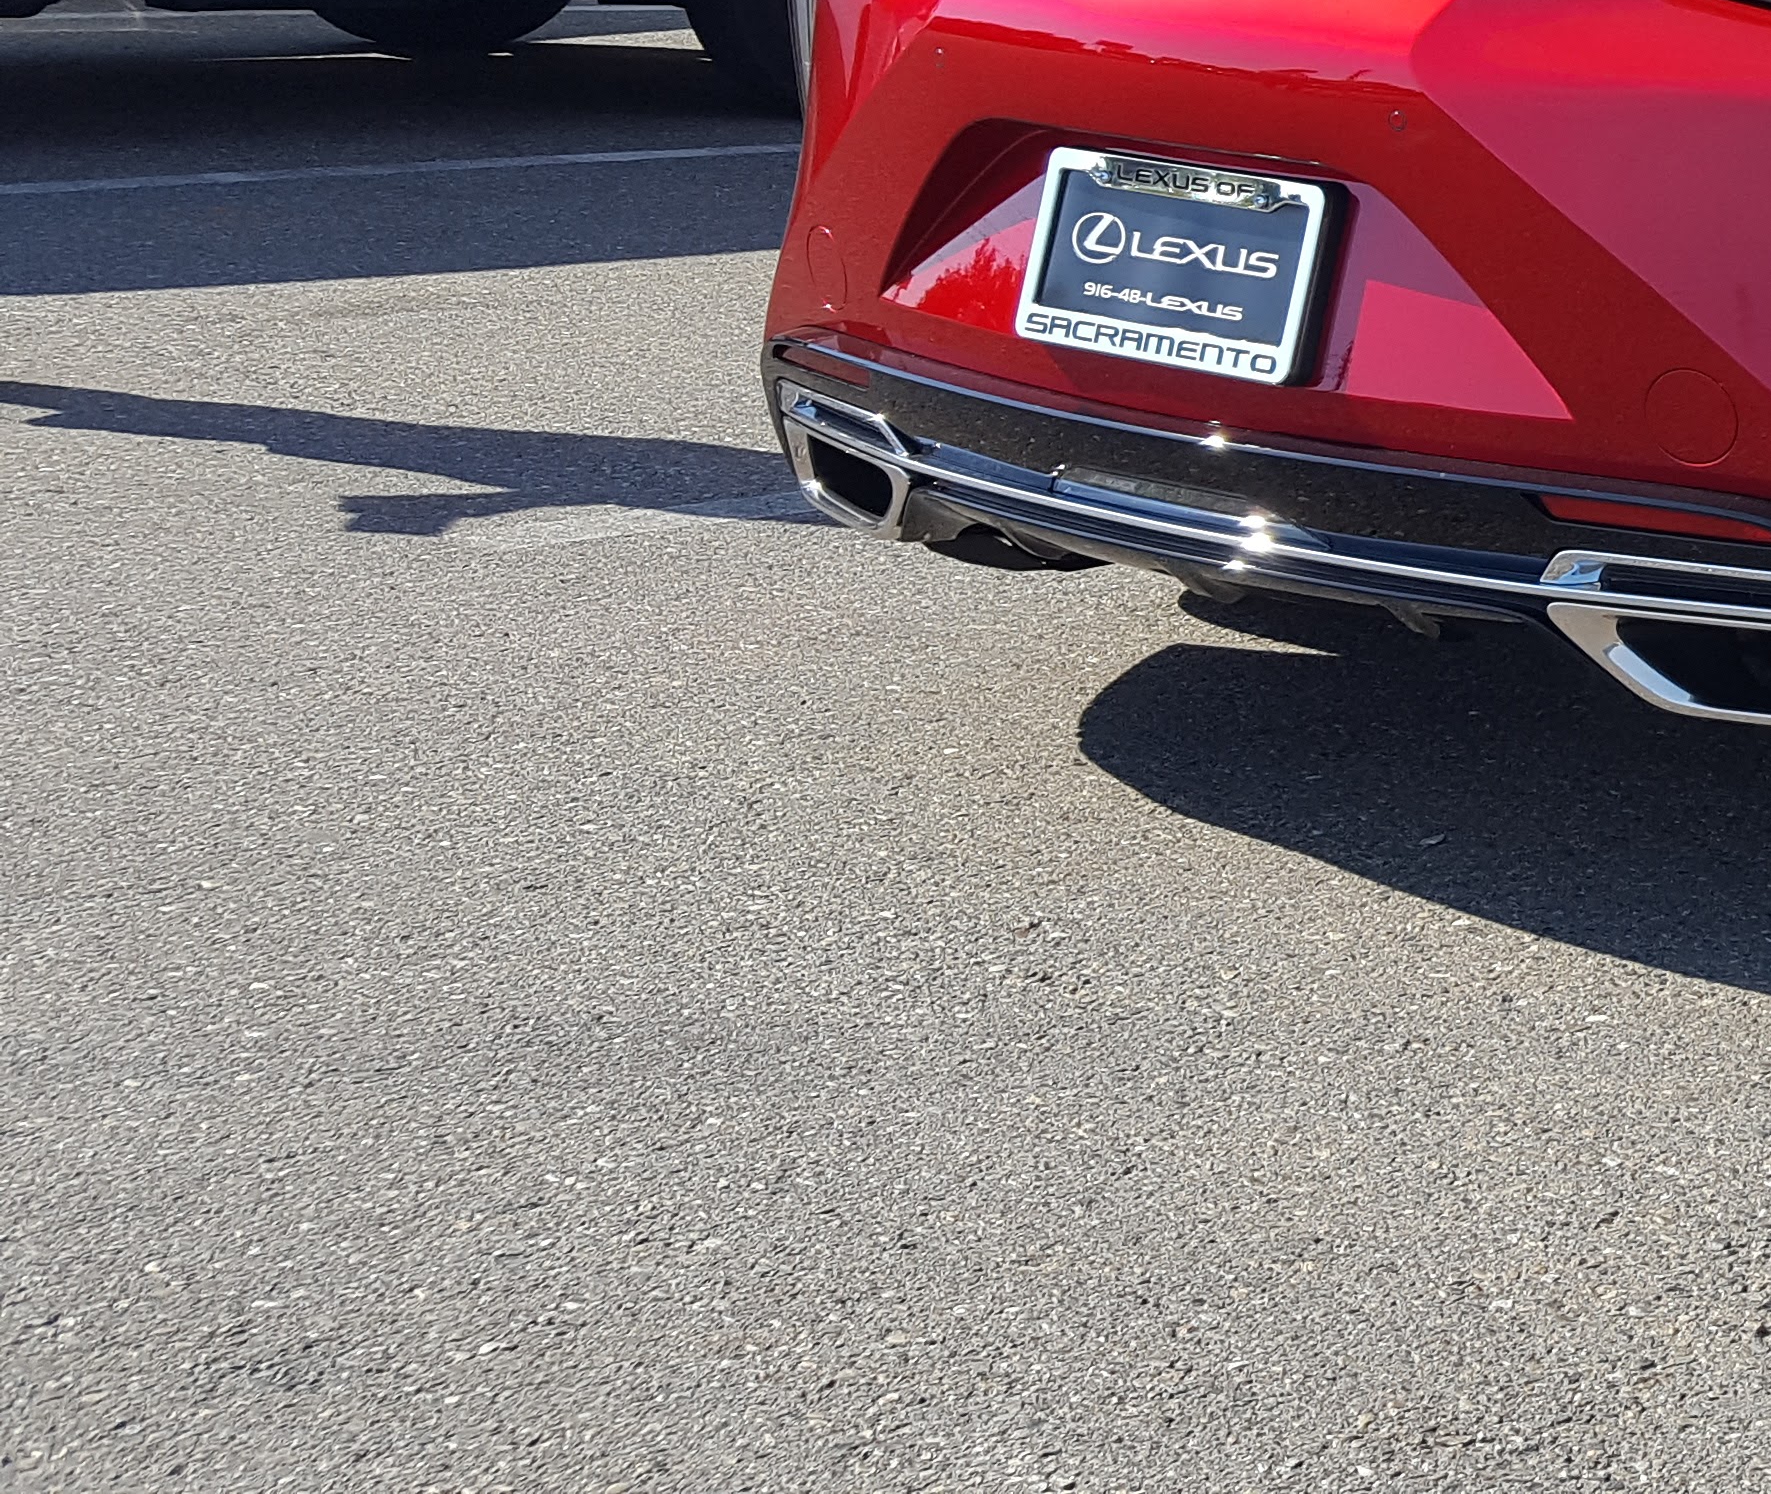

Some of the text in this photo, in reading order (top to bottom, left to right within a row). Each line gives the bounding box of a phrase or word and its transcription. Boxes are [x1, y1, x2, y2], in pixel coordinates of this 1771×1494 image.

[1116, 162, 1256, 198] LEXUS OF
[1130, 229, 1280, 280] LEXUS
[1083, 281, 1243, 322] 916-48-LEXUS
[1025, 312, 1276, 374] SACRAMENTO
